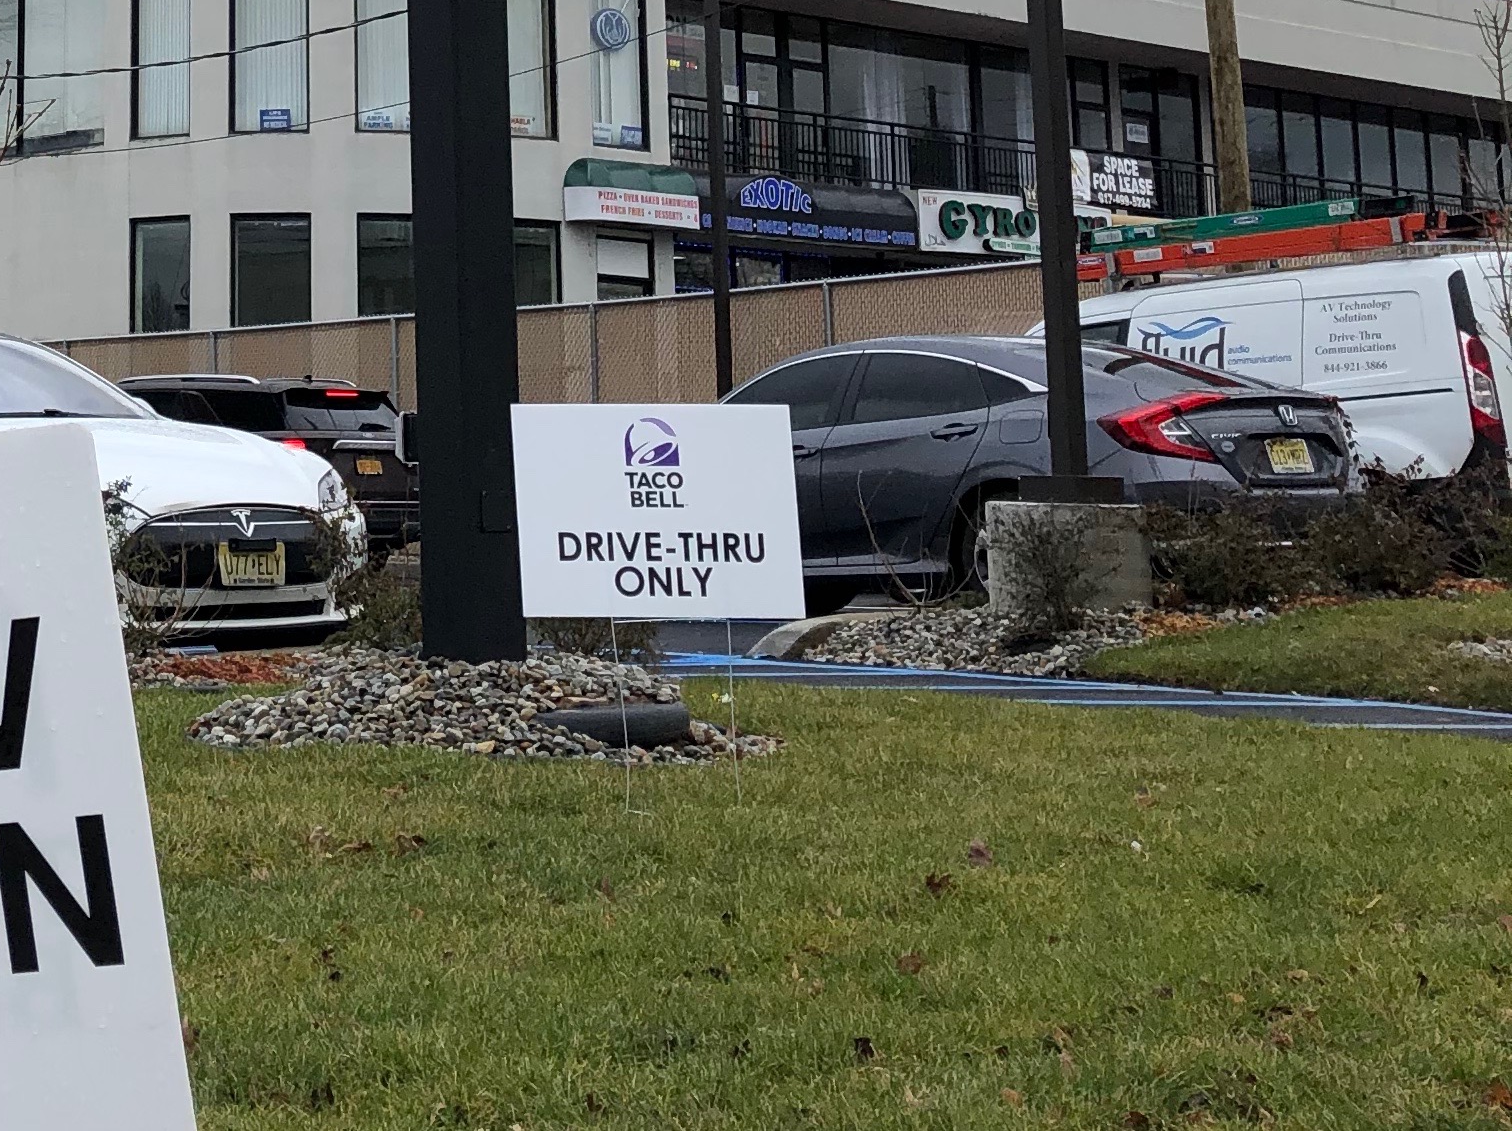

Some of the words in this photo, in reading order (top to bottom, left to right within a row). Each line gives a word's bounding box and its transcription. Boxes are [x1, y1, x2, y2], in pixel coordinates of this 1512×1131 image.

[1103, 155, 1140, 177] SPACE
[1092, 172, 1117, 192] FOR
[1118, 175, 1155, 197] LEASE
[597, 190, 618, 201] PIZZA
[623, 192, 639, 203] OVEN
[640, 194, 660, 206] BAKED
[740, 177, 813, 214] EXOTIC
[922, 196, 938, 206] NEW
[600, 204, 627, 215] FRENCH
[627, 206, 645, 217] FRIES
[938, 200, 1038, 241] GYRO
[1320, 303, 1335, 312] AV
[1338, 299, 1393, 311] Technology
[1333, 313, 1378, 324] Solutions
[1328, 330, 1383, 343] Drive-Thru
[1227, 344, 1250, 355] audio
[1314, 342, 1397, 356] Communications
[1227, 354, 1293, 366] communications
[624, 471, 684, 489] TACO
[630, 490, 685, 508] BELL
[557, 531, 766, 563] DRIVE-THRU
[614, 566, 714, 598] ONLY
